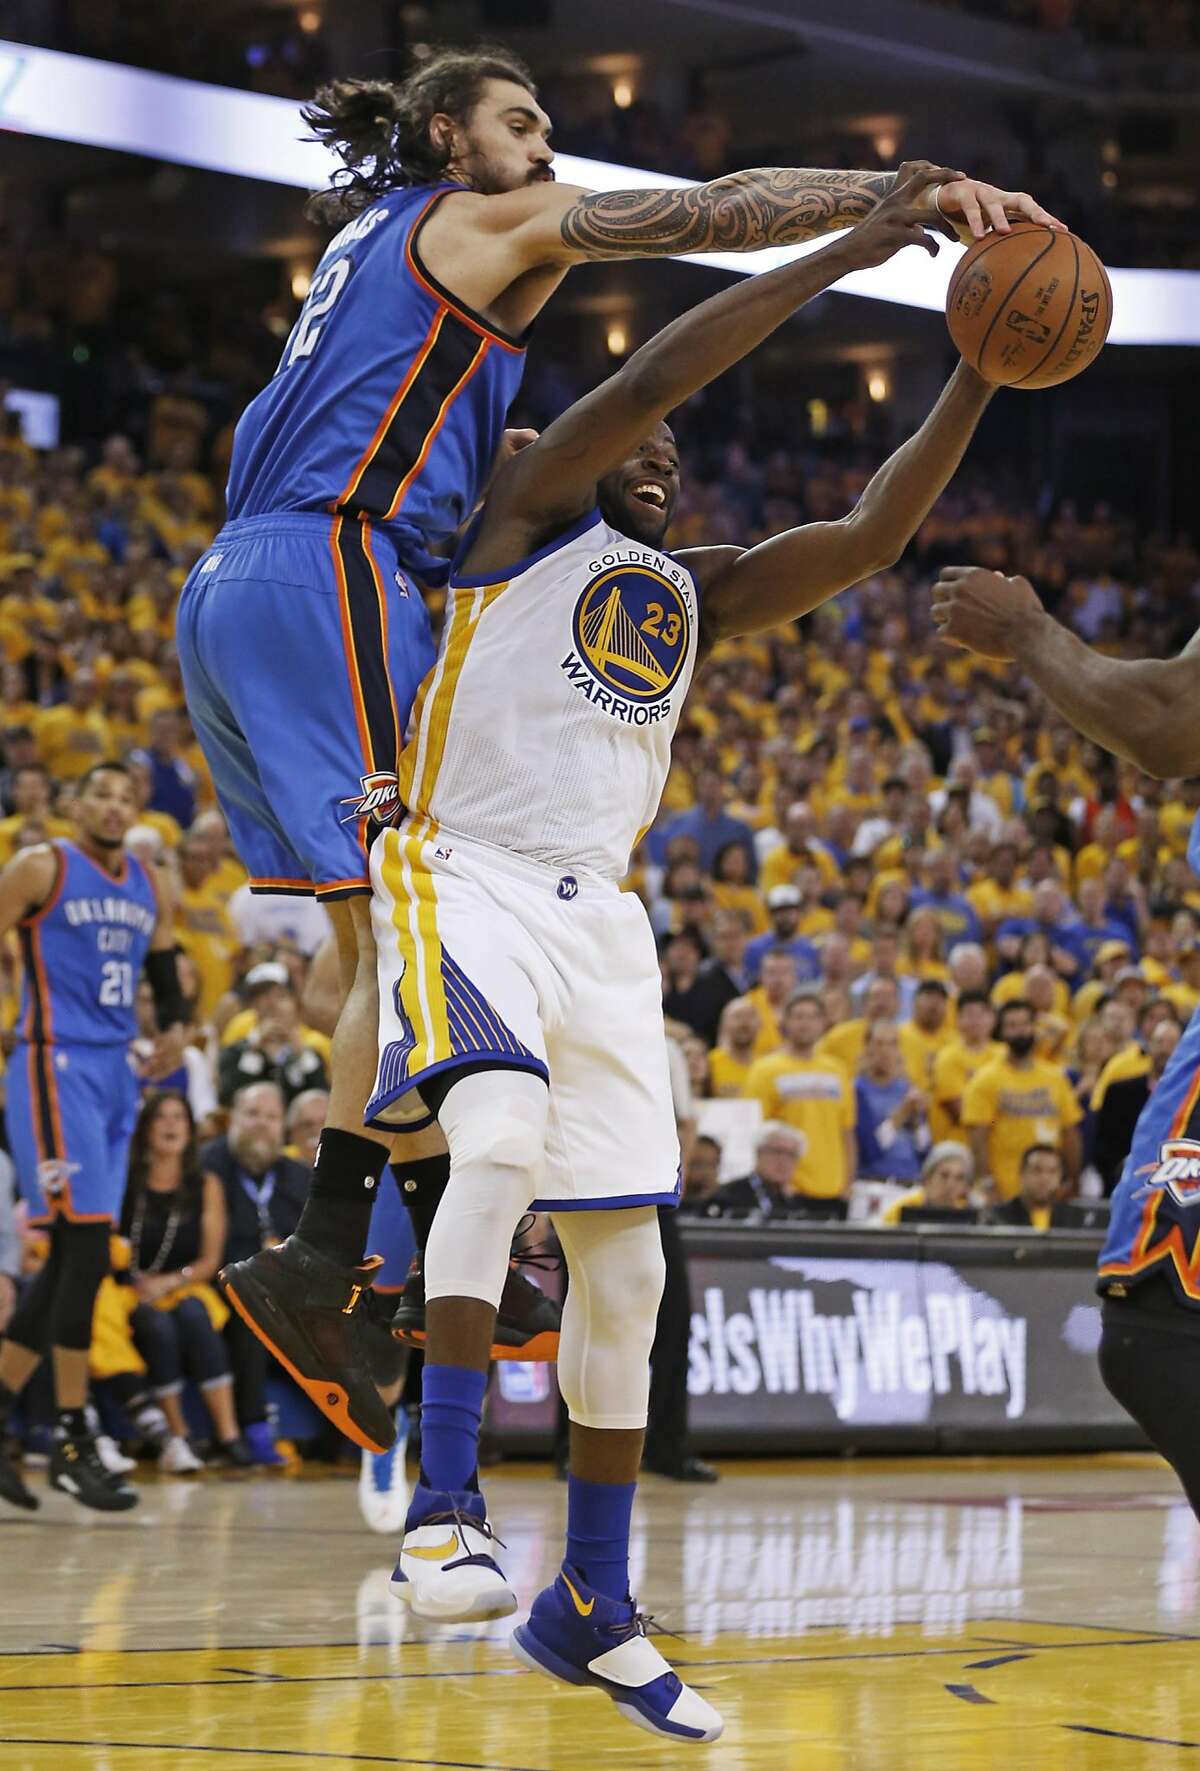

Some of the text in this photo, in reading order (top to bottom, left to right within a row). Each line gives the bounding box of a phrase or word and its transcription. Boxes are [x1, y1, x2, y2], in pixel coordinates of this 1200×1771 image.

[588, 550, 666, 573] GOLDEN
[640, 602, 682, 647] 23
[560, 651, 672, 726] WARRIORS
[99, 960, 133, 1008] 21
[687, 1287, 1027, 1419] sIsWhyWePlay
